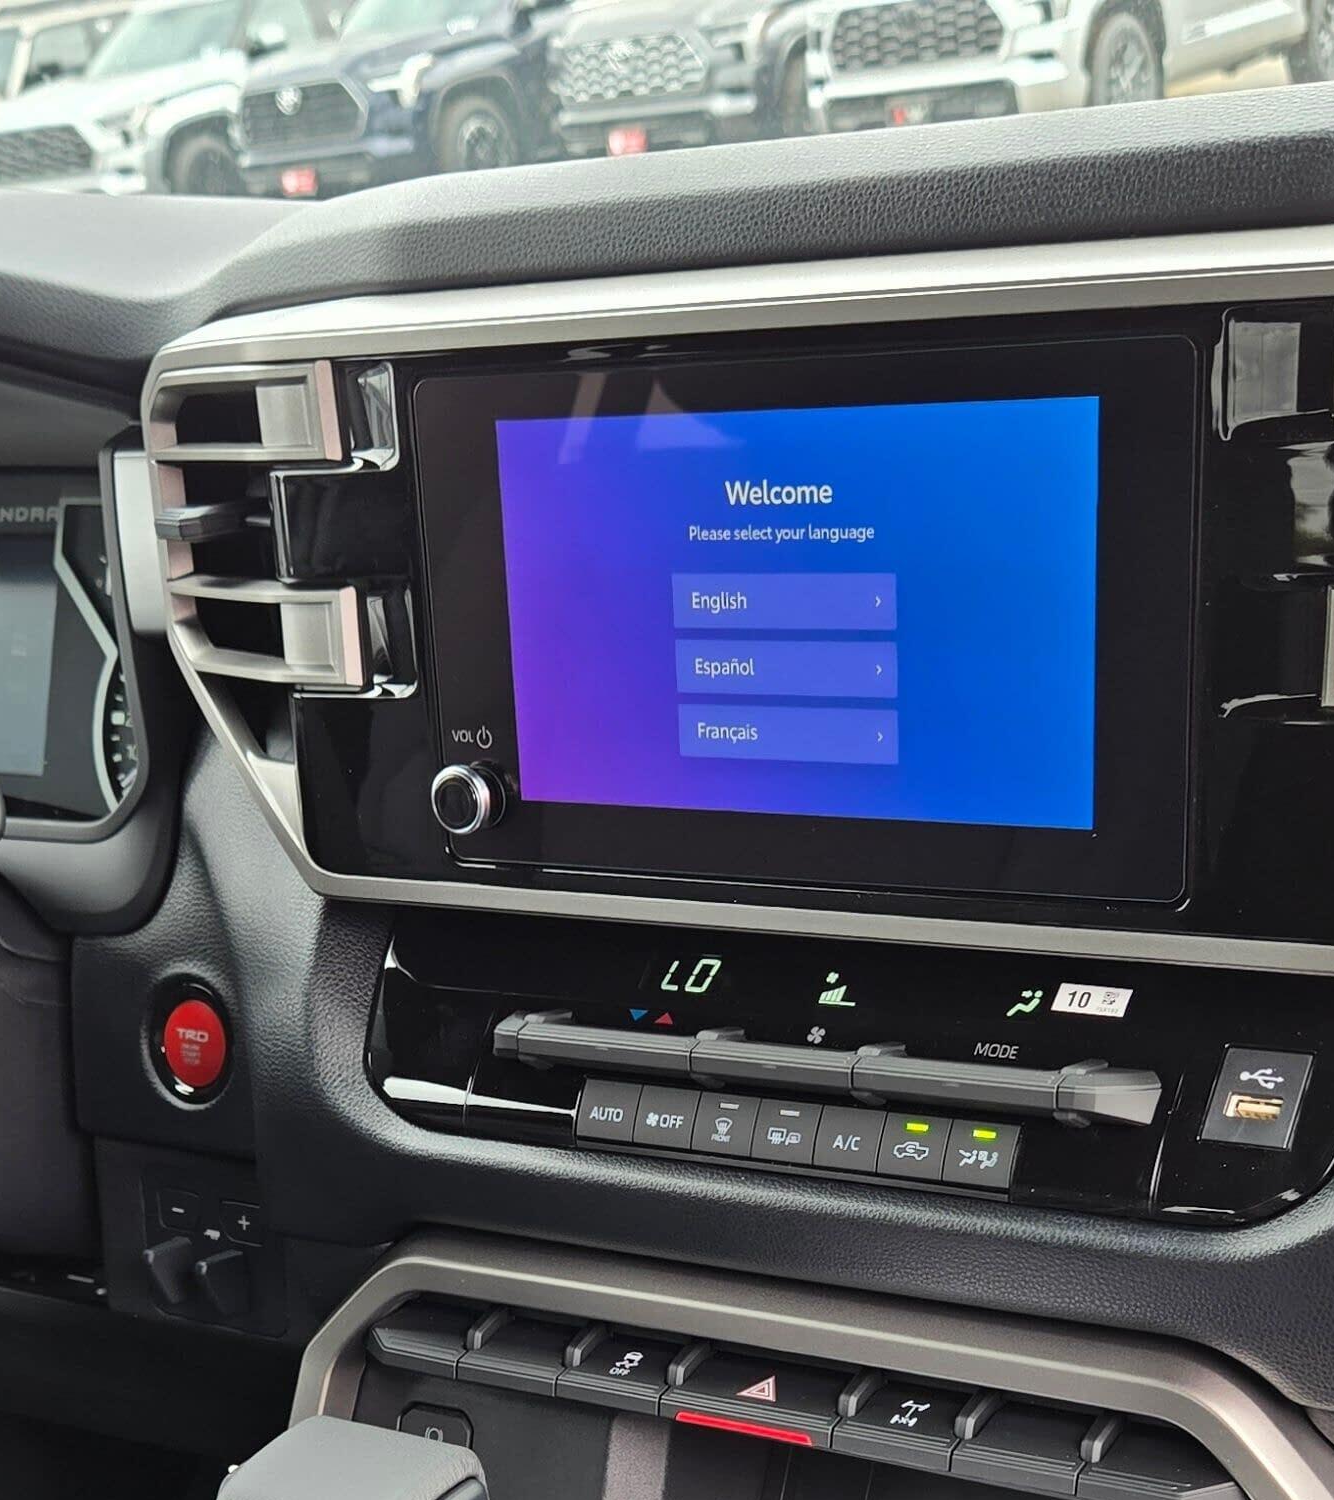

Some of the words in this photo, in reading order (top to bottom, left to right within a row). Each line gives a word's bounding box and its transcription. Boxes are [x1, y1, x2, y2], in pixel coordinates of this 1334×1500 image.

[725, 480, 833, 505] Welcome
[689, 526, 731, 541] Please
[734, 525, 772, 540] select
[775, 526, 805, 543] your
[808, 524, 875, 542] language
[691, 592, 747, 613] English
[695, 658, 755, 678] Español
[451, 729, 474, 743] VOL
[698, 722, 758, 744] Français
[660, 958, 722, 993] LO
[1068, 991, 1091, 1008] 10
[176, 1027, 209, 1043] TRD
[974, 1042, 1019, 1060] MODE
[589, 1106, 624, 1123] AUTO
[659, 1112, 684, 1130] OFF
[711, 1132, 731, 1143] FRONT
[832, 1134, 862, 1151] A/C
[609, 1367, 631, 1376] OFF
